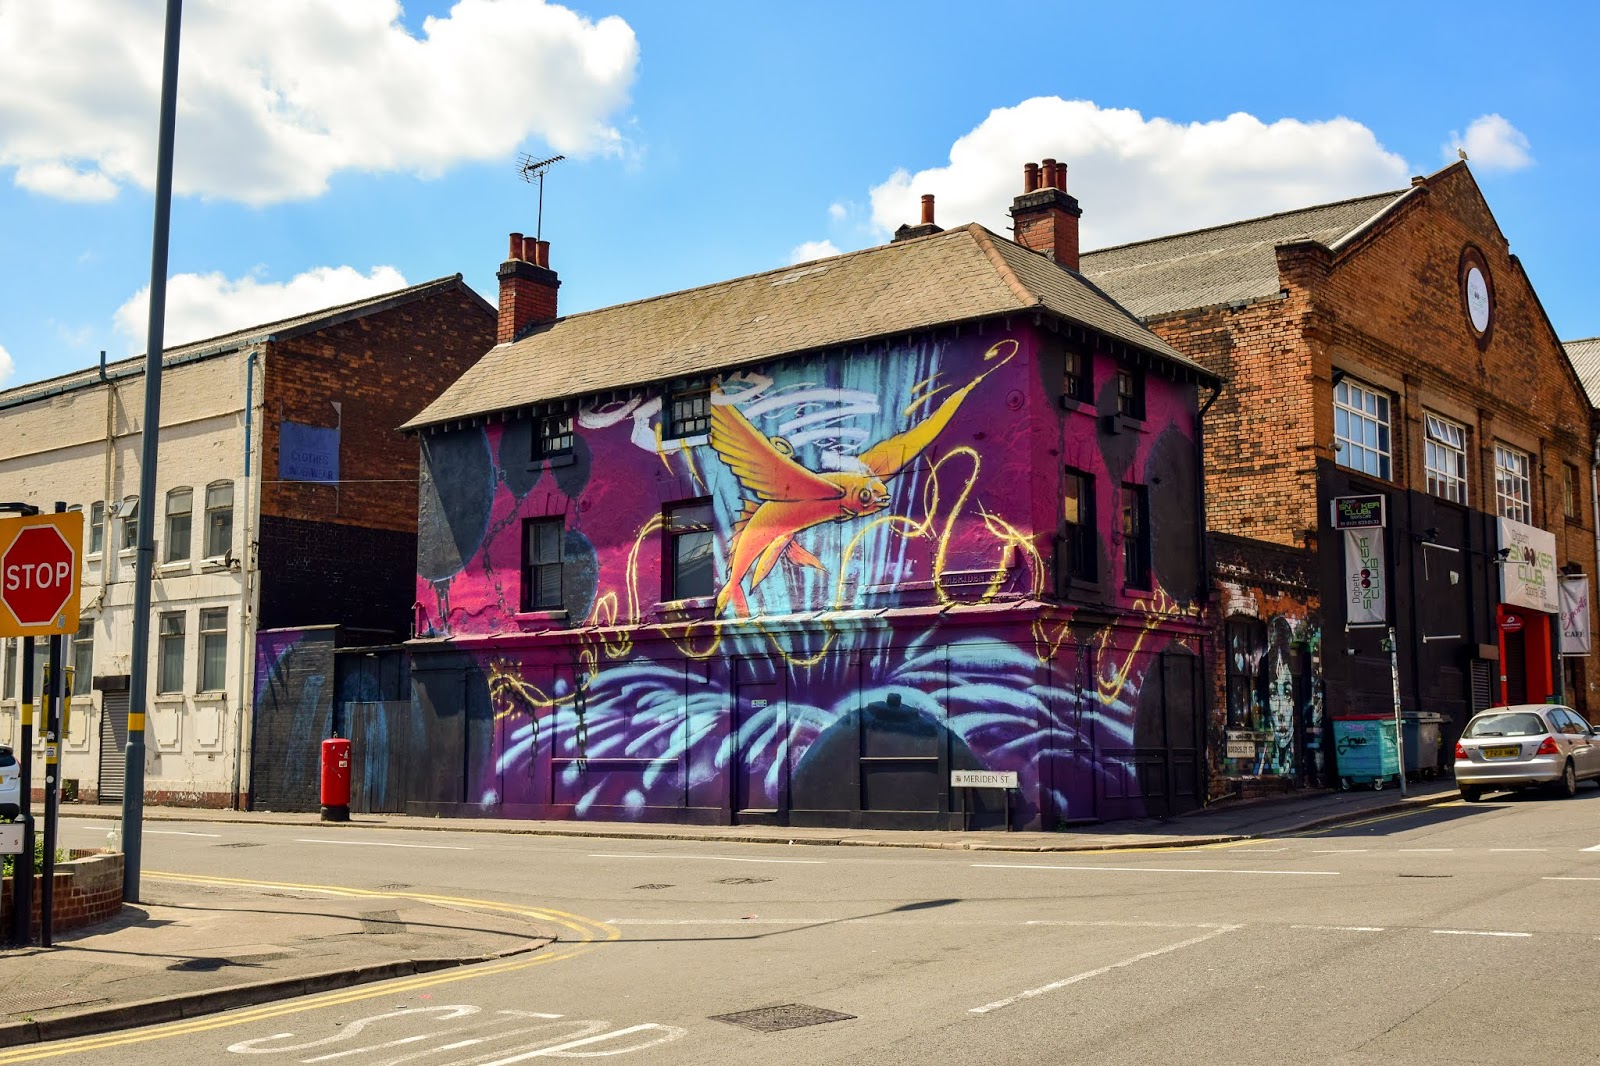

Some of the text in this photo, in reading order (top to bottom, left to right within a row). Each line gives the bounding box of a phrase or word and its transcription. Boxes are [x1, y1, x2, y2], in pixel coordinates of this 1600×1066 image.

[291, 449, 329, 465] CLOTHES
[1344, 508, 1369, 516] CLUB
[6, 561, 70, 591] STOP
[1371, 558, 1380, 600] CLUB
[1517, 565, 1543, 586] CLUB
[1352, 573, 1362, 604] Digbeth
[1560, 595, 1587, 631] Sports
[963, 775, 1010, 784] MERIDEN ST
